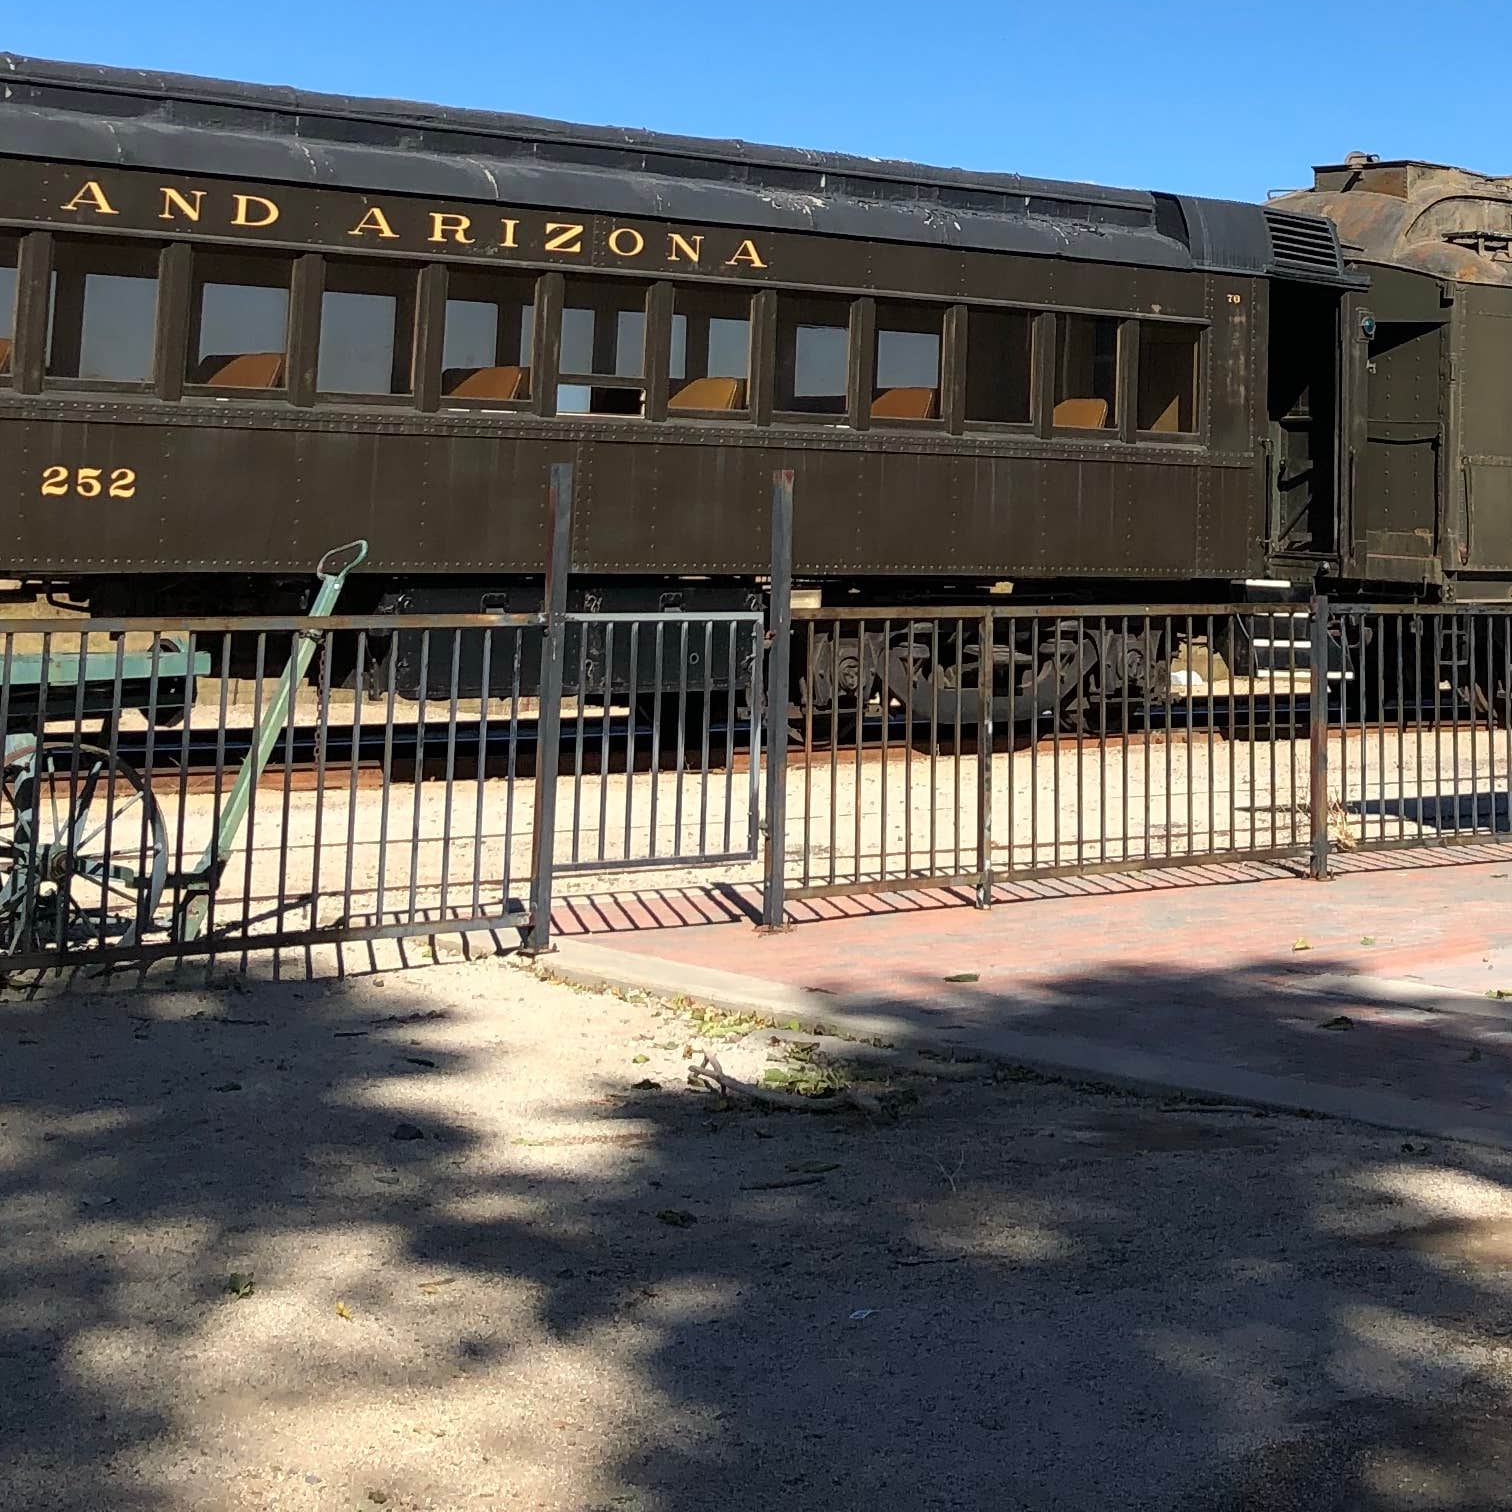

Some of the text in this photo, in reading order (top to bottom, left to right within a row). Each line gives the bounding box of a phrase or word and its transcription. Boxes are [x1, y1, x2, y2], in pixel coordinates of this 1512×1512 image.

[60, 181, 768, 268] AND ARIZONA
[41, 465, 137, 499] 252
